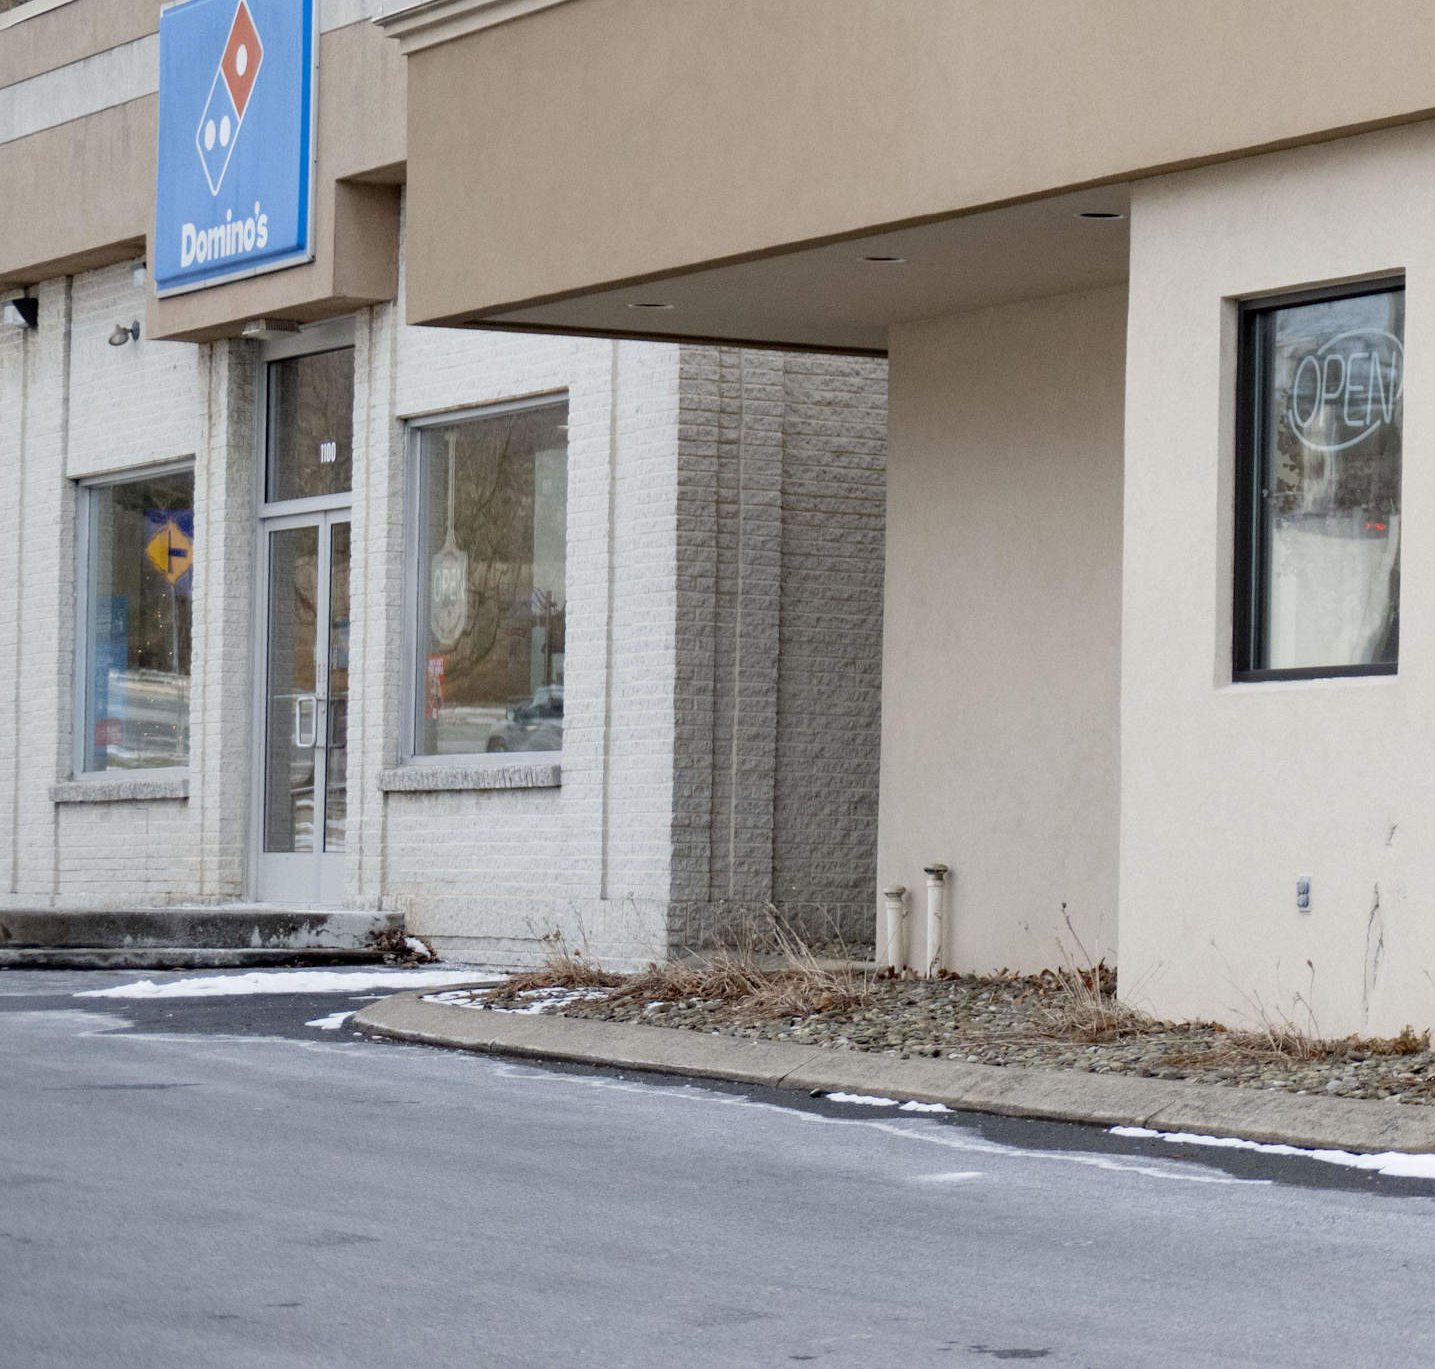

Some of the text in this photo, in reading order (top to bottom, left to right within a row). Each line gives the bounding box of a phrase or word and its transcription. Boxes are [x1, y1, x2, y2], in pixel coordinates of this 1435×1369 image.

[180, 200, 268, 269] Domino's
[1293, 351, 1396, 428] OPEN
[320, 441, 336, 463] 1100
